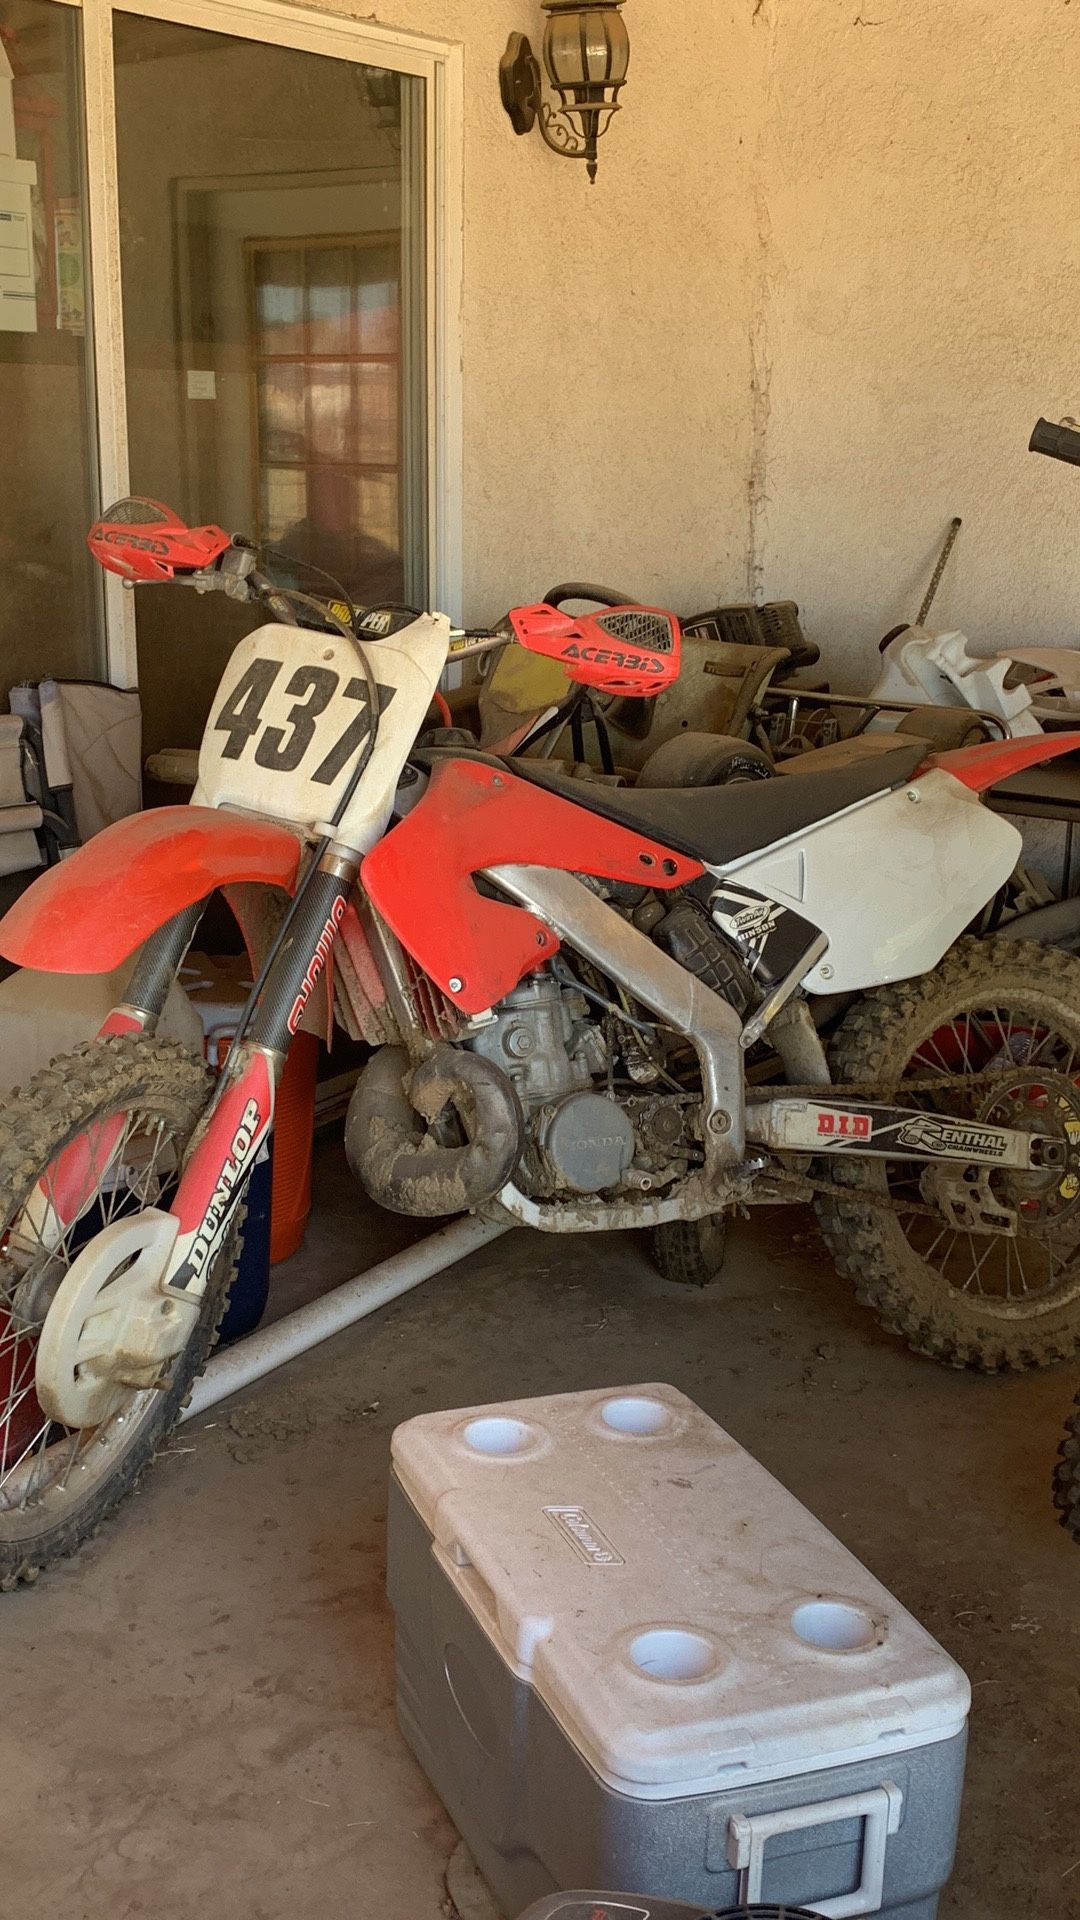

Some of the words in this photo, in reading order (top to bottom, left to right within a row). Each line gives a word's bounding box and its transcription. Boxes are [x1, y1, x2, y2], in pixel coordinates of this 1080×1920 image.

[561, 643, 665, 673] ACERBIS
[214, 657, 398, 786] 437
[569, 1136, 627, 1151] ONDA
[187, 1098, 261, 1278] DUNLOP
